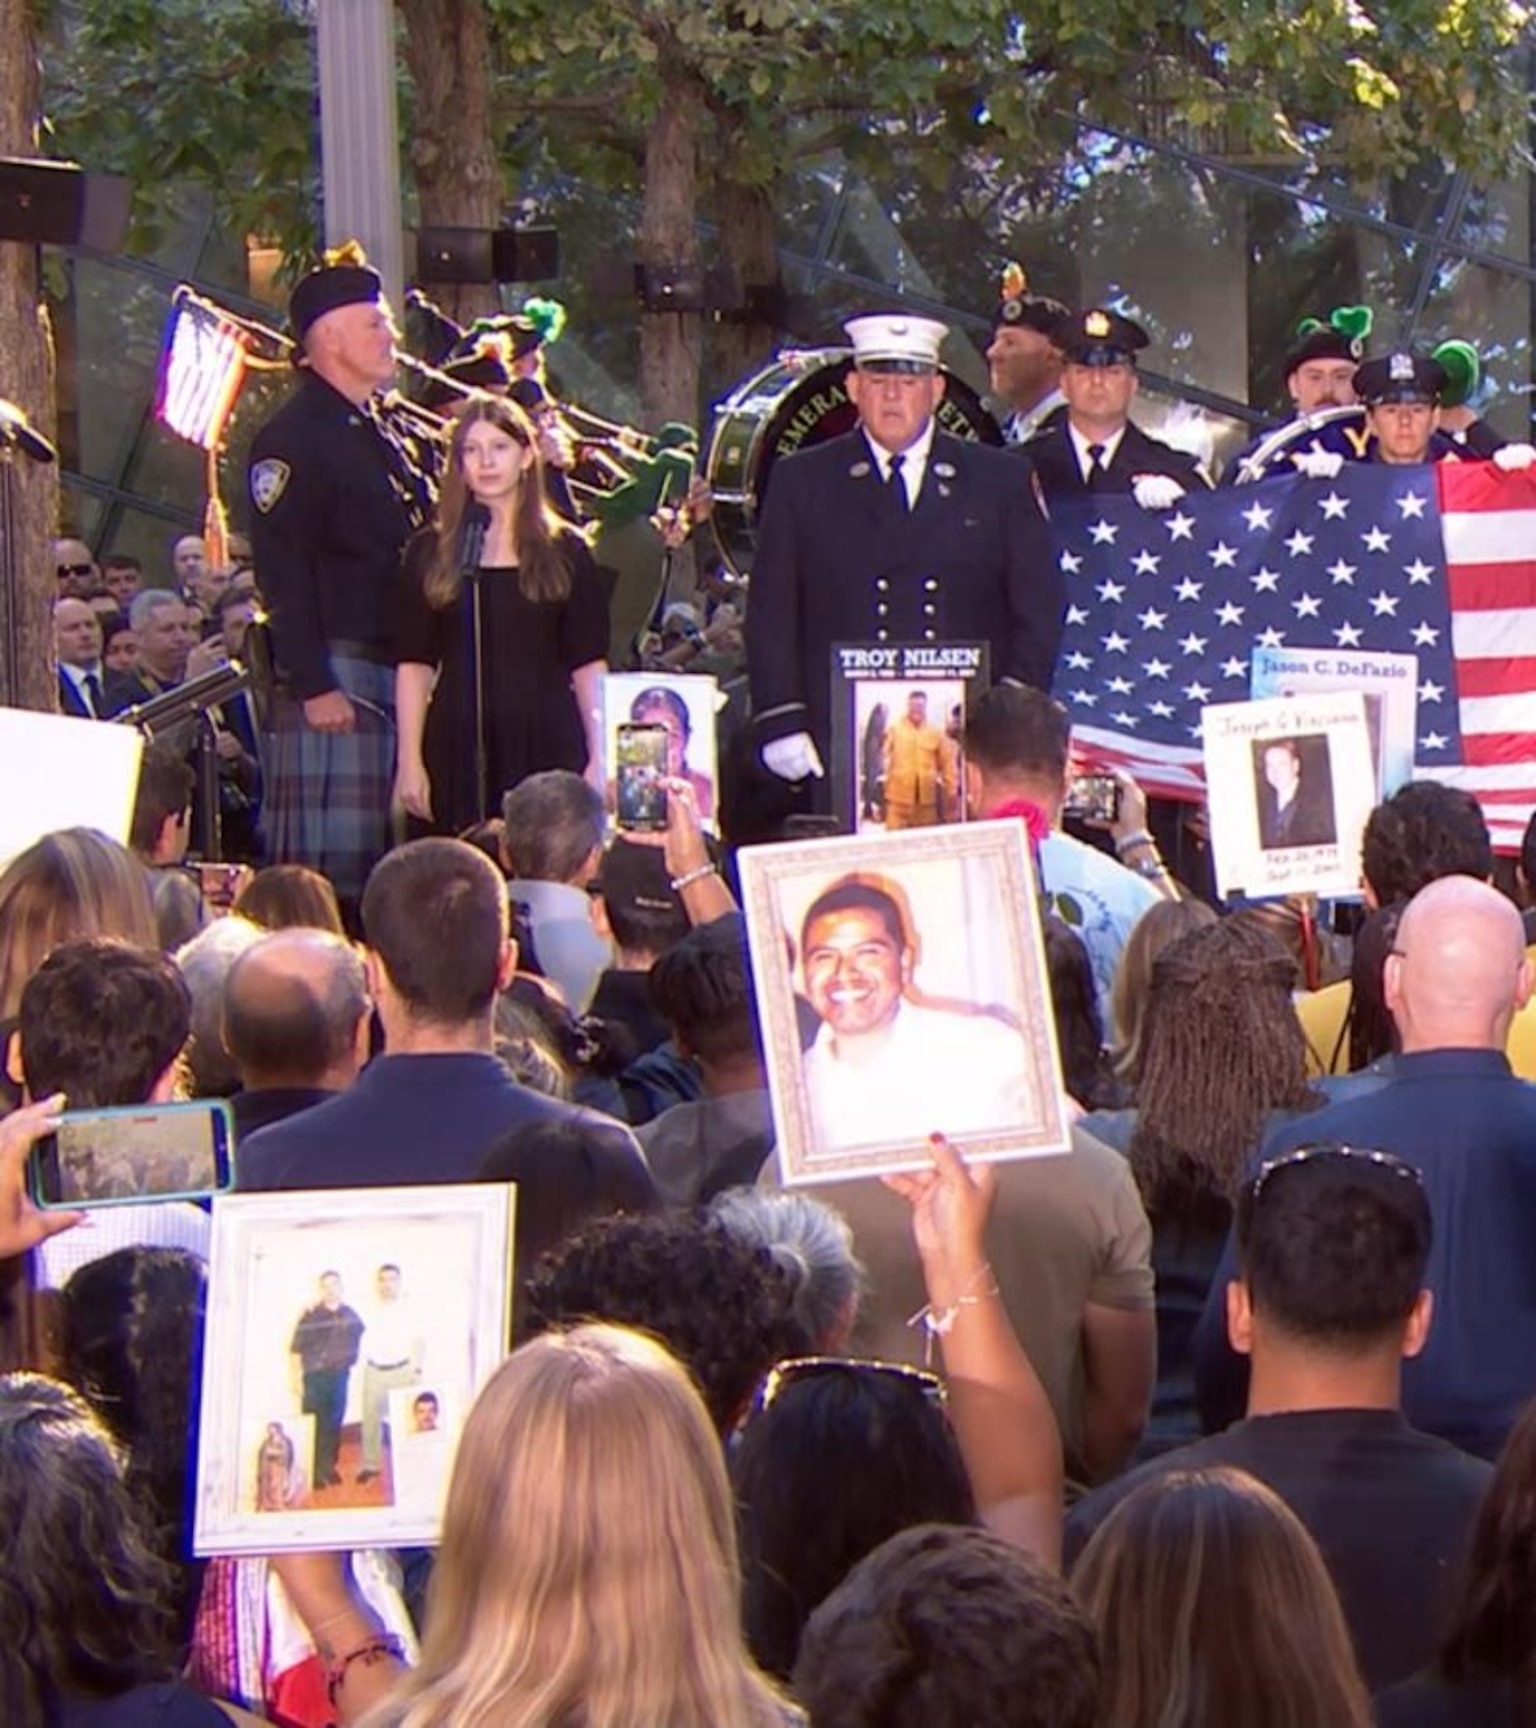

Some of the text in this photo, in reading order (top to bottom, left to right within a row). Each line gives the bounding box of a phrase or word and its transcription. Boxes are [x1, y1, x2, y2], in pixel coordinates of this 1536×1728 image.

[776, 385, 846, 457] EMERA
[840, 648, 981, 668] TROY NILSEN
[1262, 657, 1408, 678] Jason C. DeFazio
